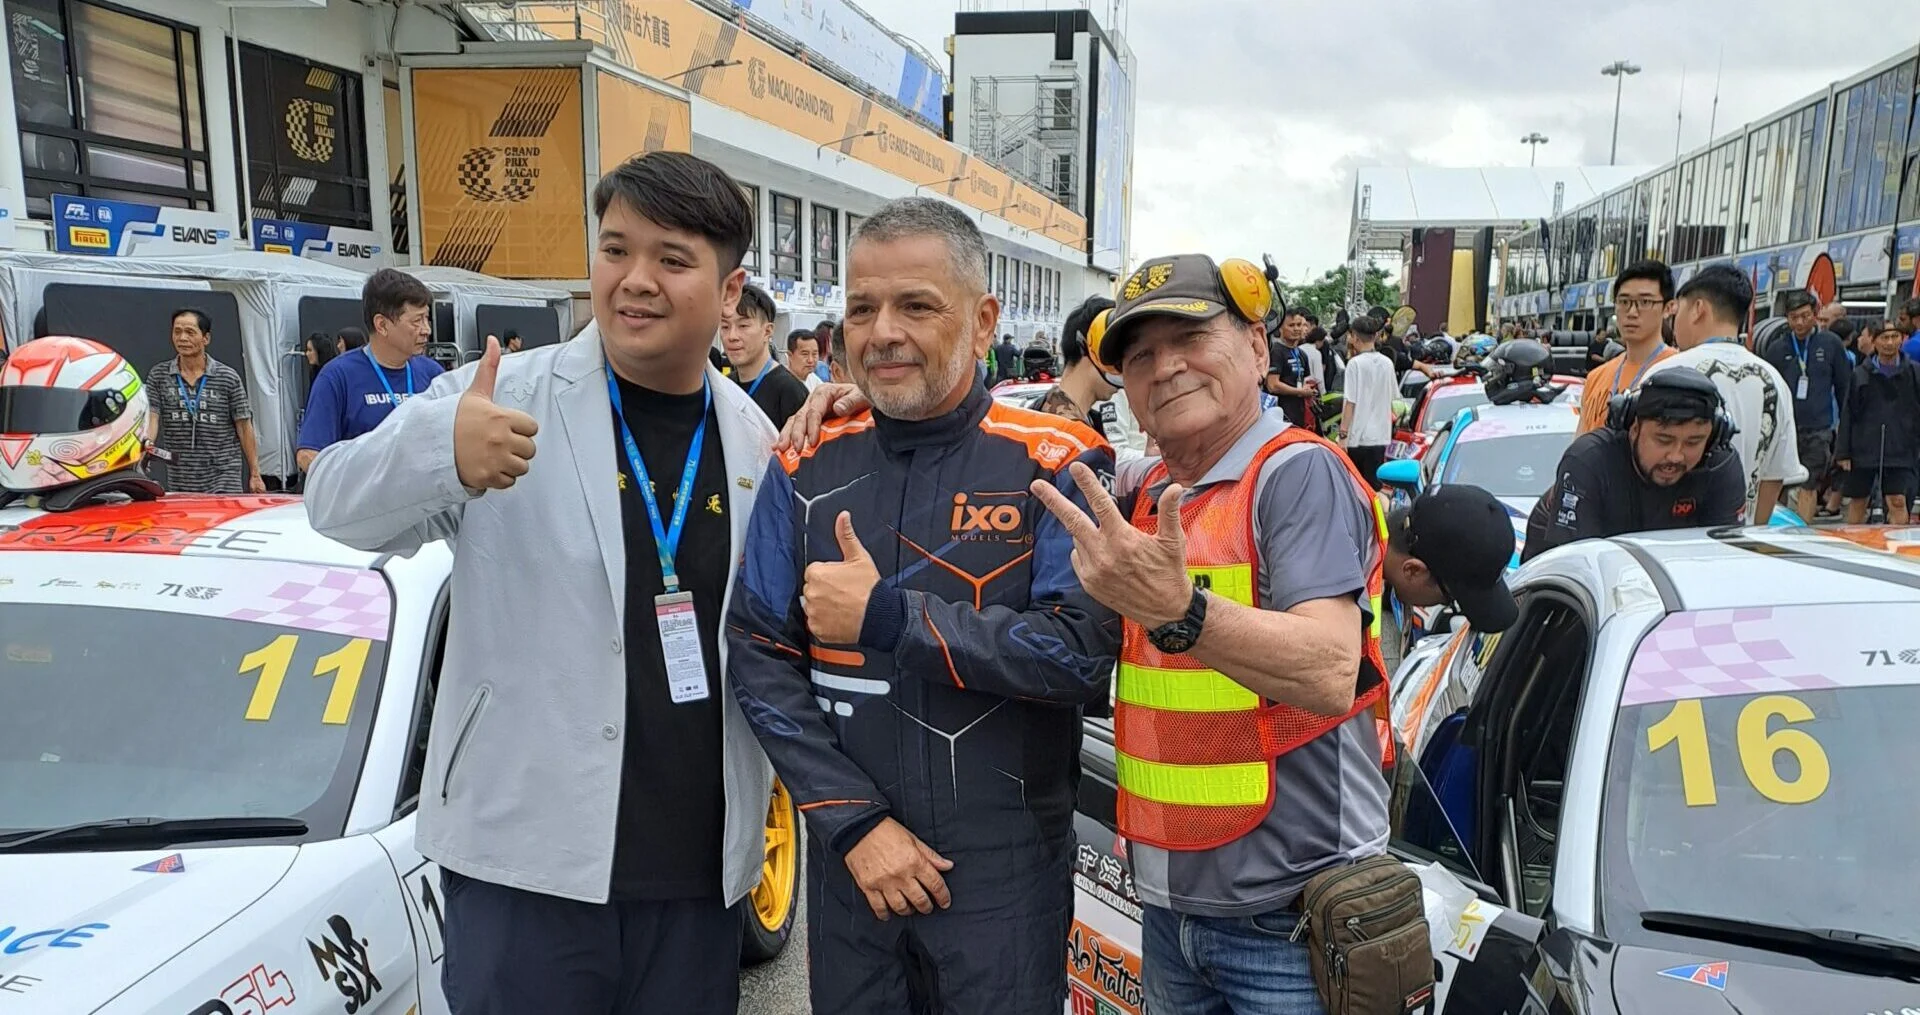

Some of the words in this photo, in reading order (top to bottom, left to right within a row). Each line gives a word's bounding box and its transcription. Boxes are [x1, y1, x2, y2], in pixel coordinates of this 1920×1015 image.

[767, 72, 793, 105] MACAU
[794, 86, 819, 115] GRAND
[313, 102, 334, 116] GRAND
[504, 146, 541, 156] GRAND
[505, 157, 528, 167] PRIX
[504, 168, 541, 178] MACAU
[74, 231, 107, 245] PIRELLI
[172, 225, 217, 245] EVANS
[337, 242, 371, 259] EVANS
[951, 492, 1021, 531] ixo
[951, 534, 1000, 542] MODELS
[156, 582, 183, 597] 71
[1860, 650, 1896, 666] 71
[238, 634, 372, 727] 11
[1647, 695, 1831, 806] 16
[1074, 872, 1097, 896] CHINA
[1096, 885, 1131, 915] OVERSEAS
